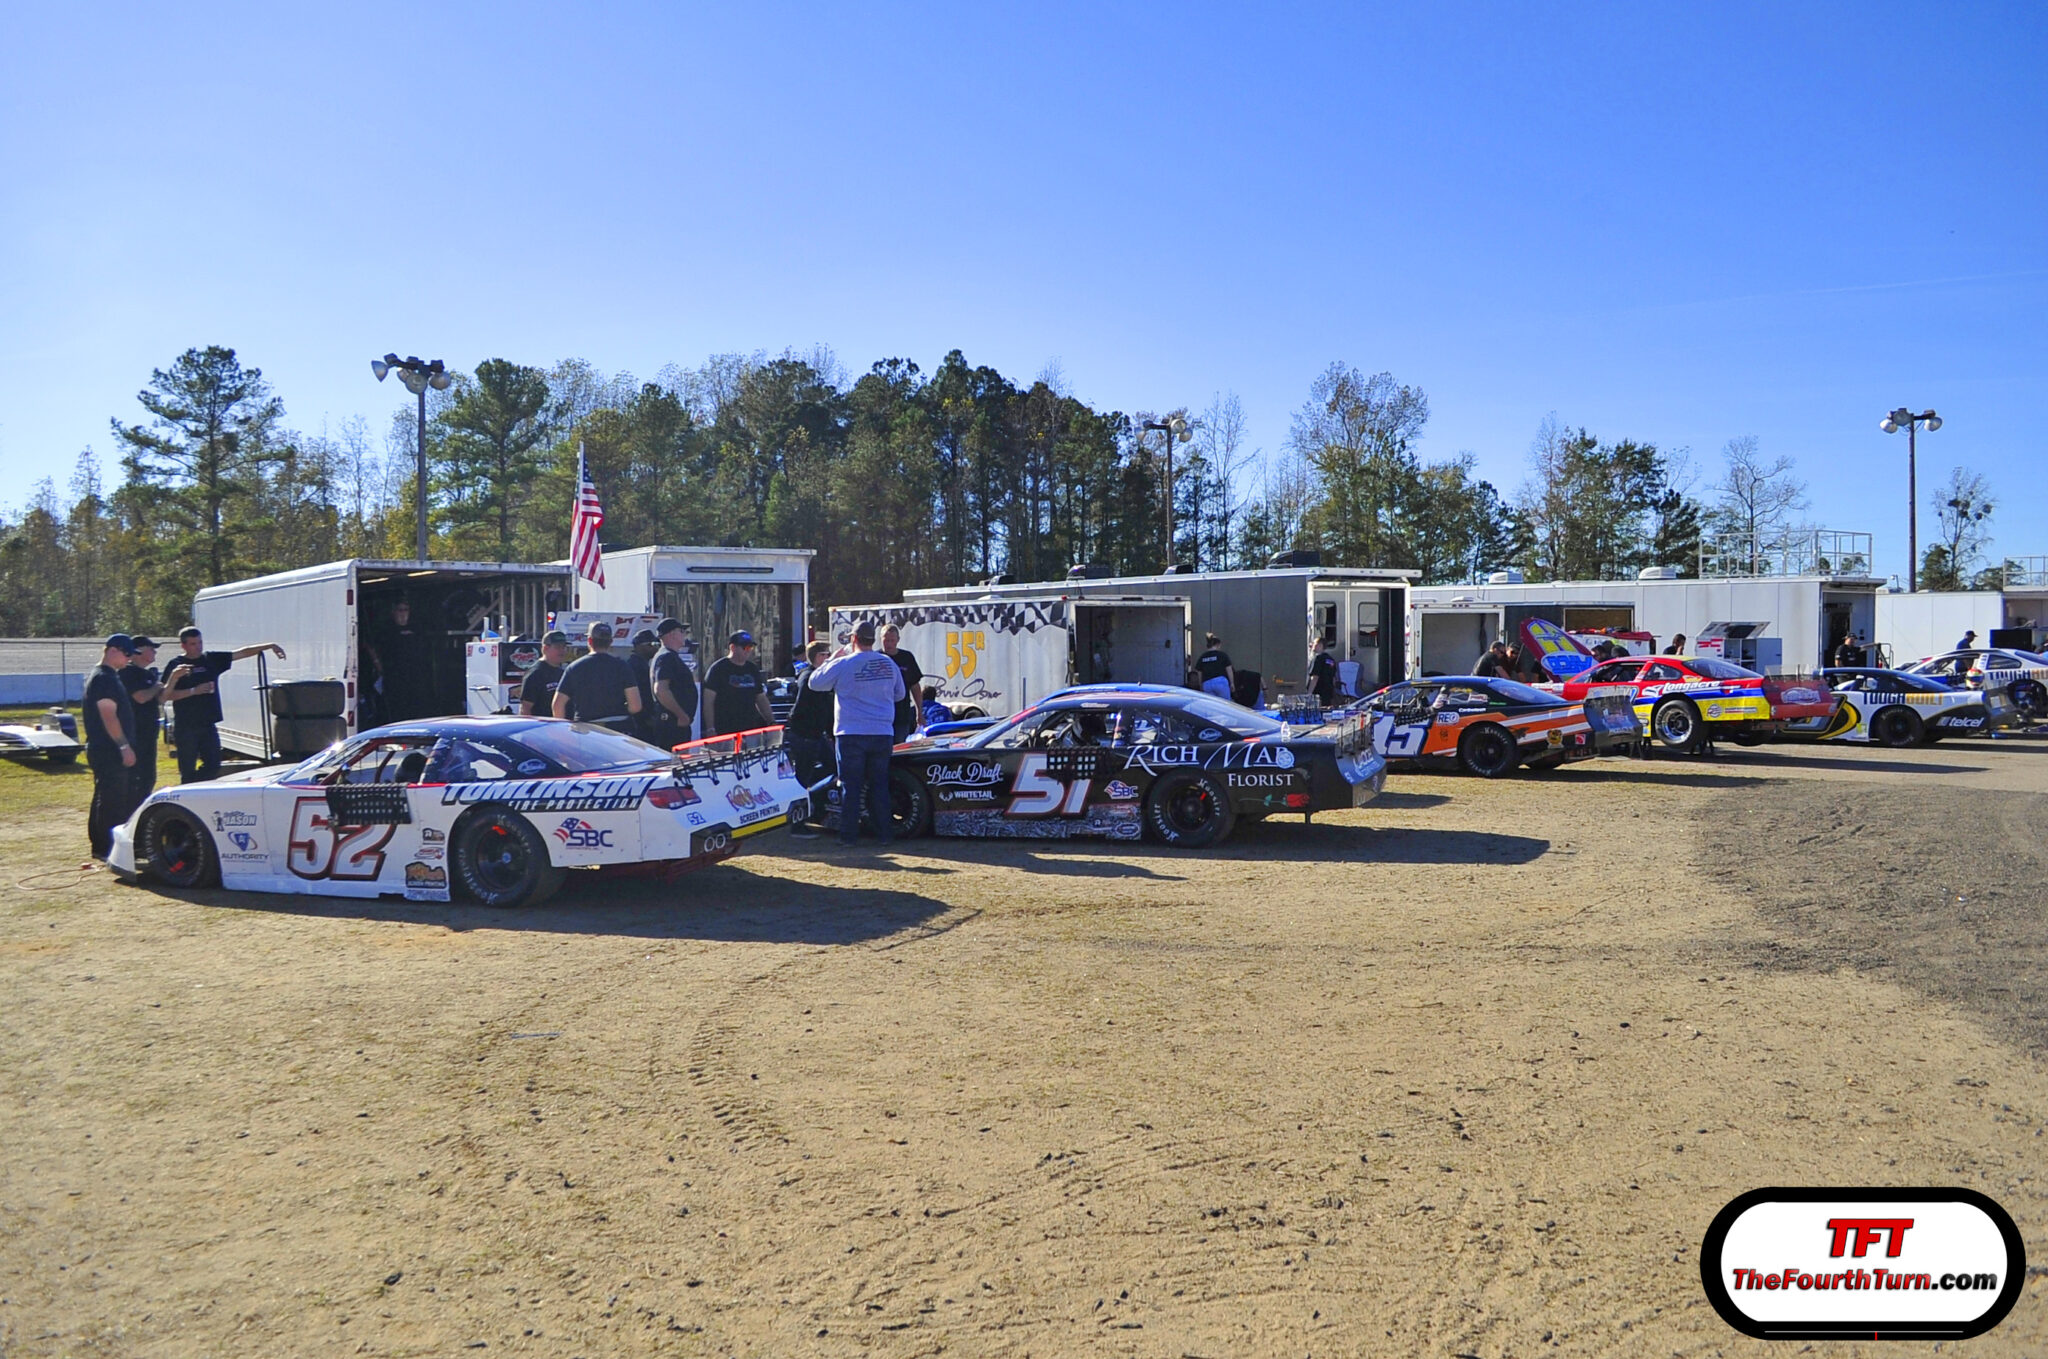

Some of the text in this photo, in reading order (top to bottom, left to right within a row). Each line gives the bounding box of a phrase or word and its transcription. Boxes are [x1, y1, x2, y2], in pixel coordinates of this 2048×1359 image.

[945, 630, 985, 679] 55R
[1864, 693, 1944, 705] TOUGHBUILT
[1950, 717, 1985, 728] telcel
[1373, 715, 1429, 756] 15
[1123, 745, 1200, 776] RICH
[926, 764, 964, 785] Black
[1004, 752, 1094, 814] 51
[1228, 773, 1294, 787] FLORIST
[441, 776, 657, 805] TOMLINSON
[1112, 785, 1139, 798] SBC
[545, 797, 641, 810] PROTECTION
[740, 803, 780, 825] SCREEN PRINTING
[287, 796, 399, 882] 52
[565, 829, 614, 848] SBC
[221, 853, 269, 861] AUTHORITY
